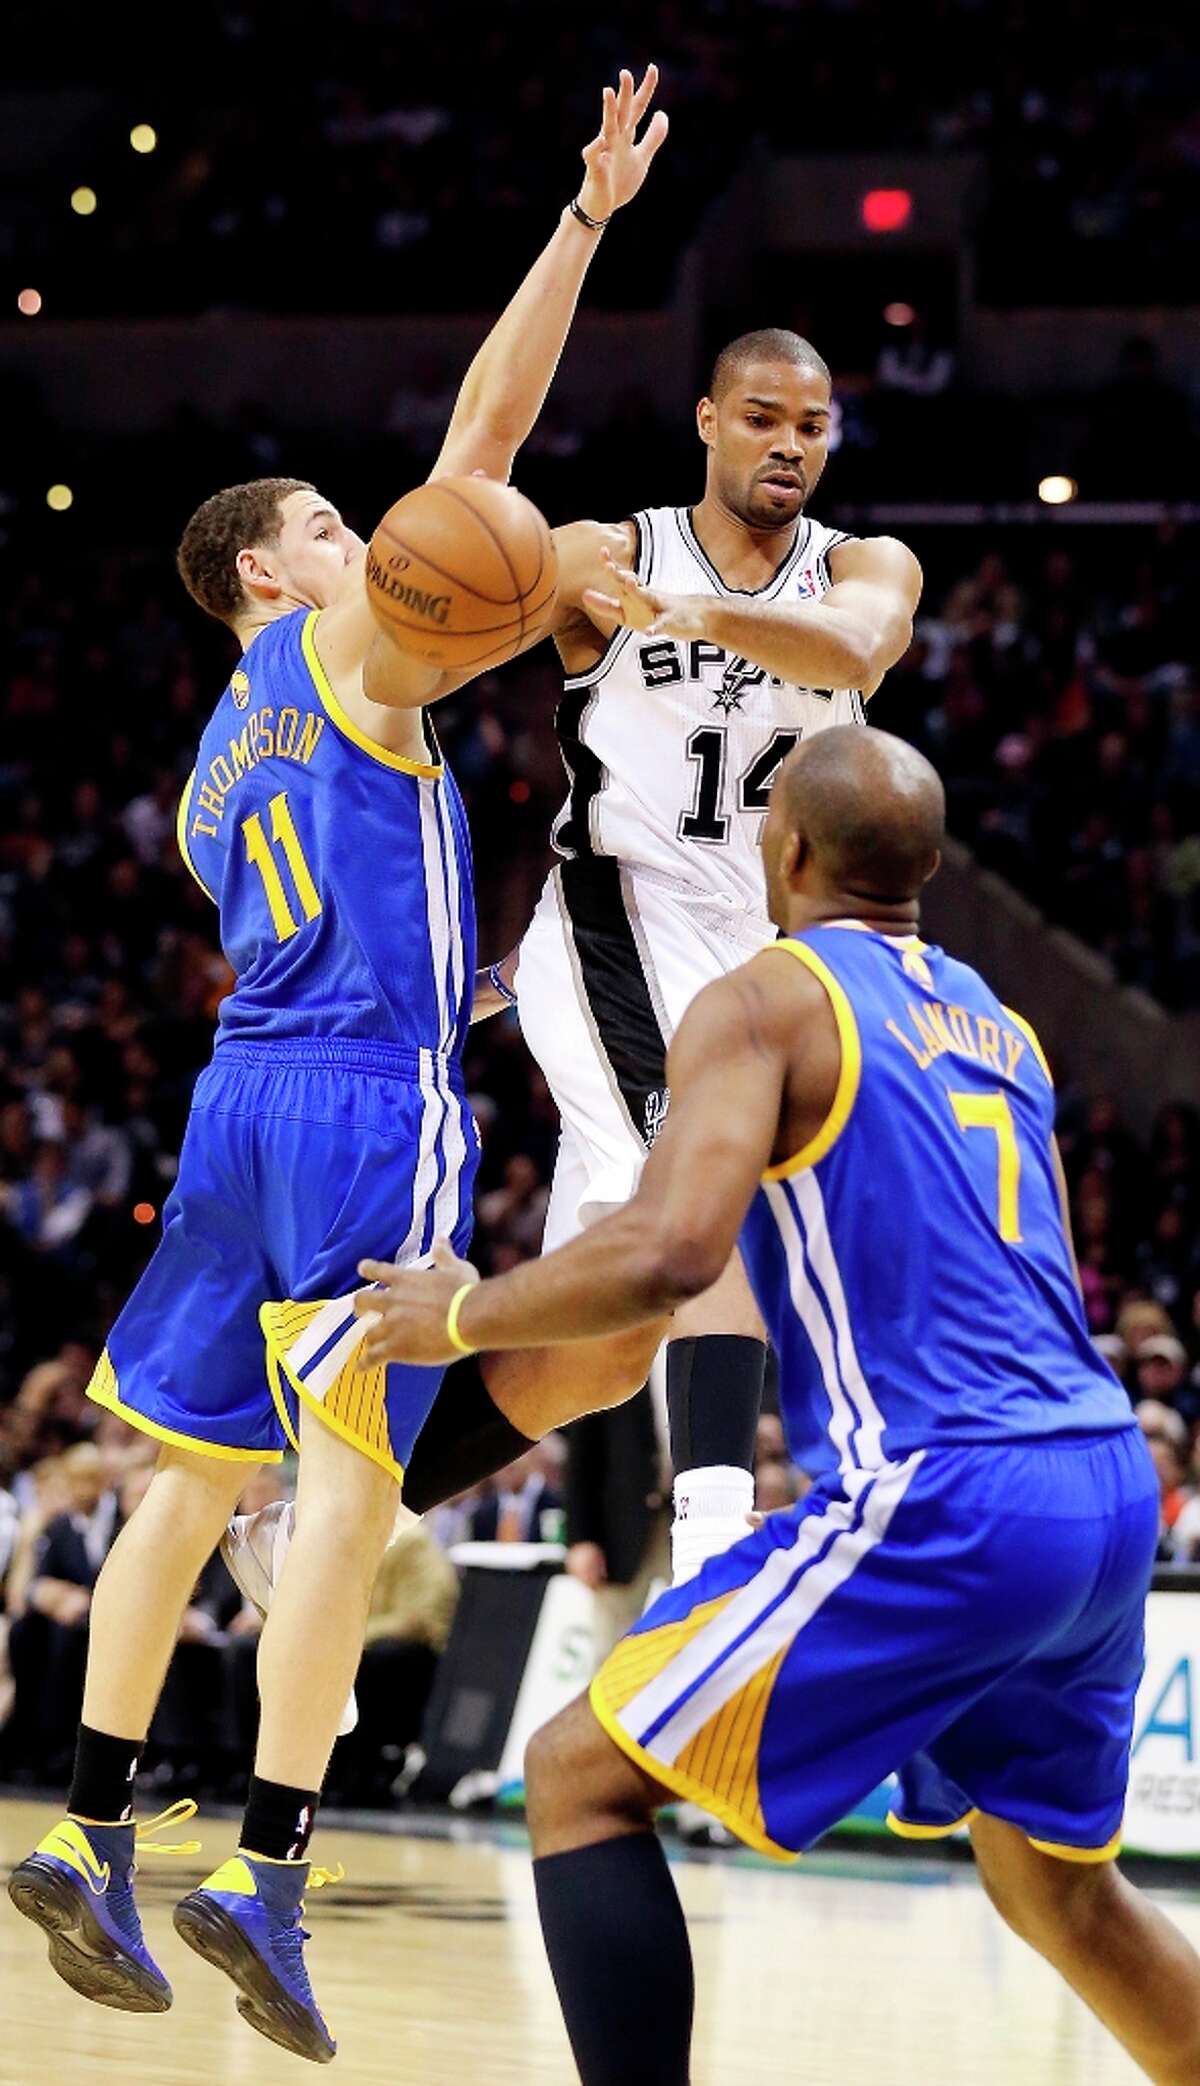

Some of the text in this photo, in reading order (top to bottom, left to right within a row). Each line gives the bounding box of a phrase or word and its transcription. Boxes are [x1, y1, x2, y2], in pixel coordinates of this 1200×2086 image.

[638, 640, 833, 702] SPU
[191, 705, 325, 838] THOMPSON
[677, 725, 803, 845] 14
[241, 791, 324, 943] 11
[885, 1001, 1024, 1081] LANDRY
[945, 1084, 1025, 1243] 7
